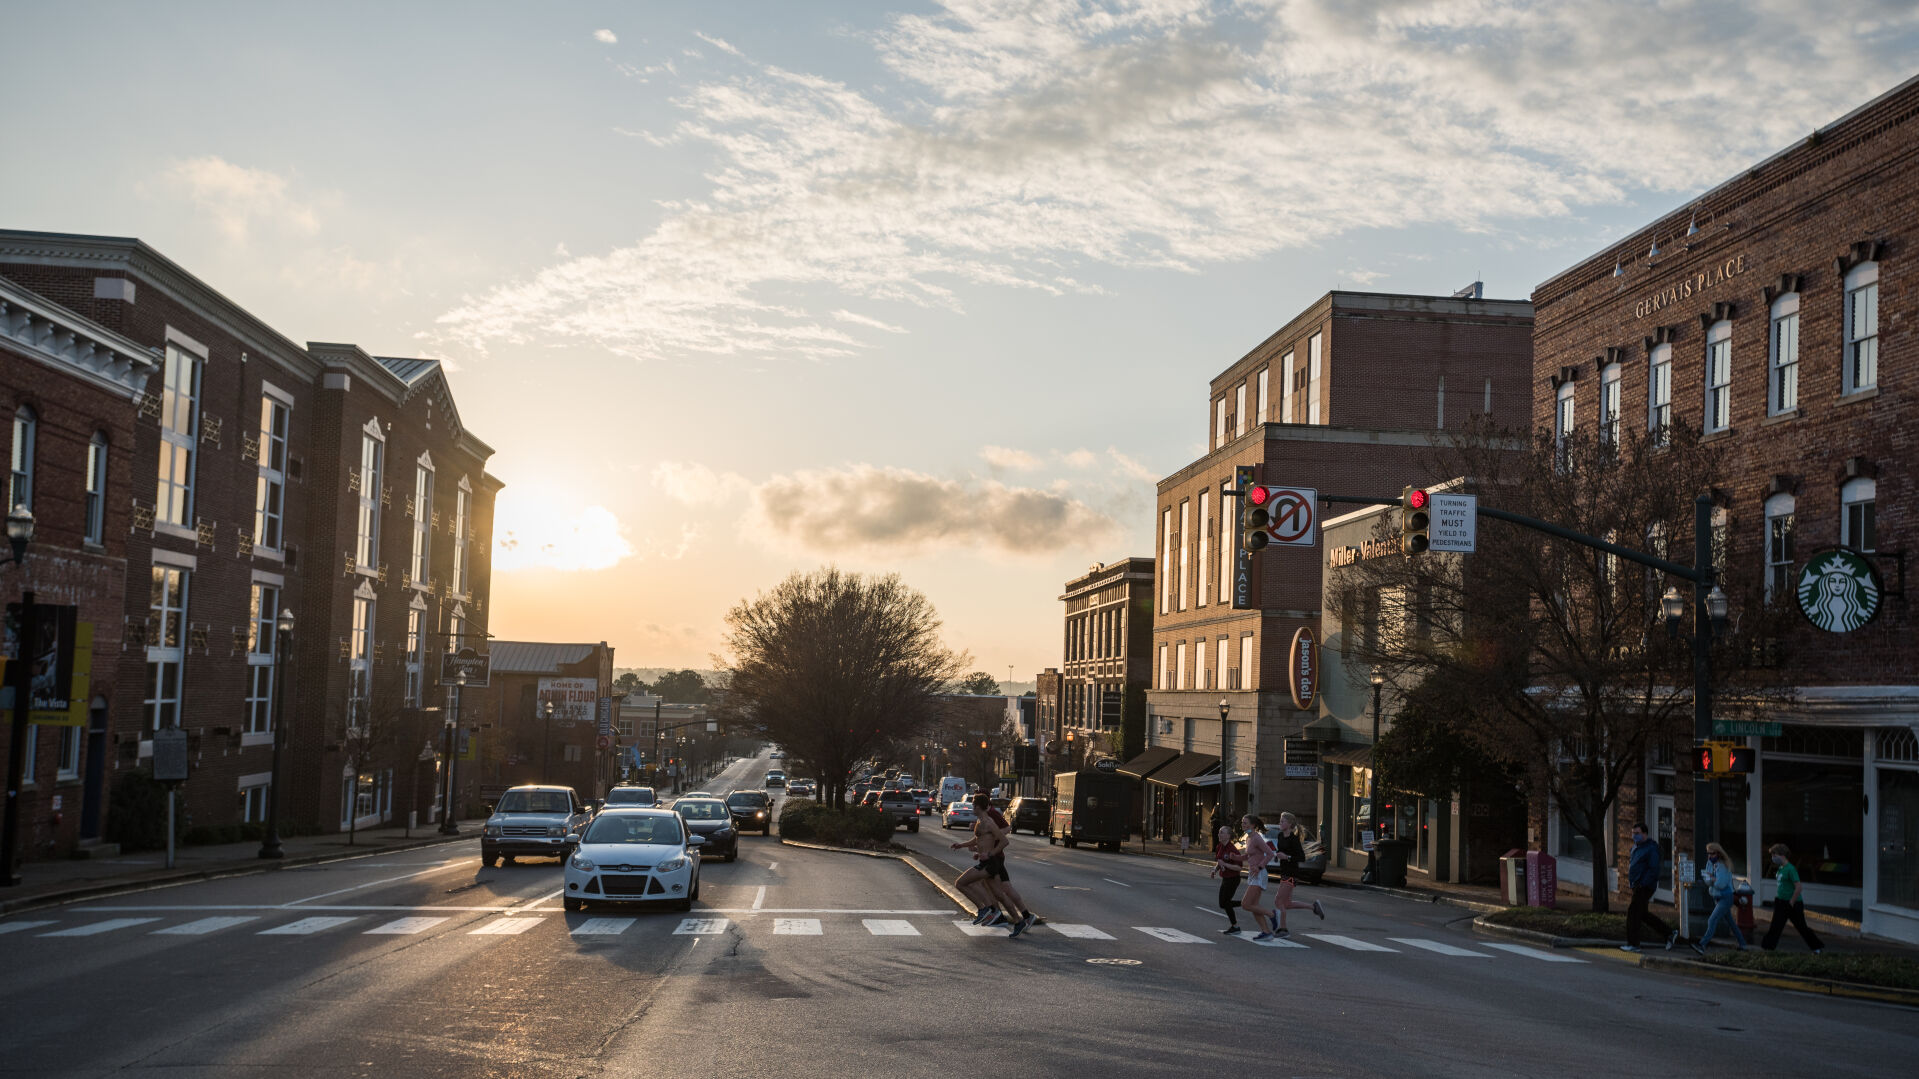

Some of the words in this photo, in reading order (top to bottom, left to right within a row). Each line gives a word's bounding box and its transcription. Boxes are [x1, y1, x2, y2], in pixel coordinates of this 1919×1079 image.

[1635, 279, 1692, 319] GERVAIS
[1698, 254, 1745, 292] PLACE
[1441, 519, 1464, 527] MUST
[1432, 539, 1472, 547] PEDESTRIANS
[1330, 545, 1356, 569] Miller
[1238, 549, 1247, 605] PLACE
[1299, 637, 1312, 676] jason's
[568, 690, 596, 703] FLOUR
[1301, 677, 1312, 699] deli
[1730, 721, 1766, 734] LINCOLN
